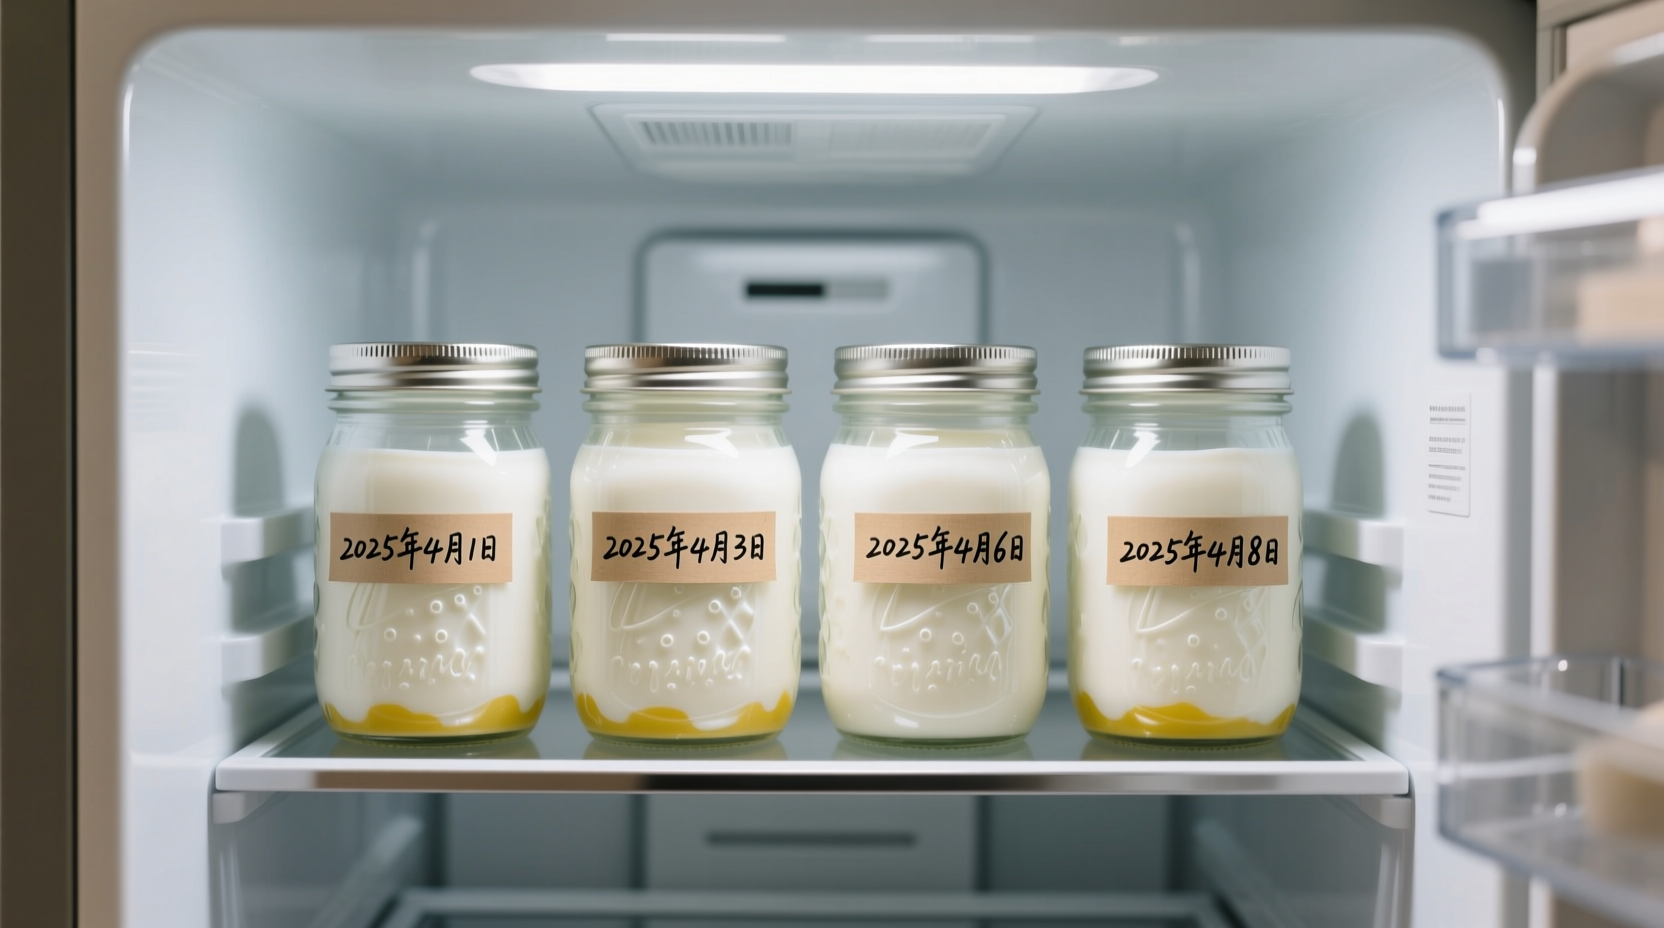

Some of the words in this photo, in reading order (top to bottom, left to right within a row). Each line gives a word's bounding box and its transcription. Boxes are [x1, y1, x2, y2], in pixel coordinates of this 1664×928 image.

[339, 526, 496, 571] 2025年4月1日
[602, 525, 765, 570] 2025年4月3日
[865, 525, 1024, 570] 2025年4月6日
[1119, 529, 1279, 574] 2025年4月8日
